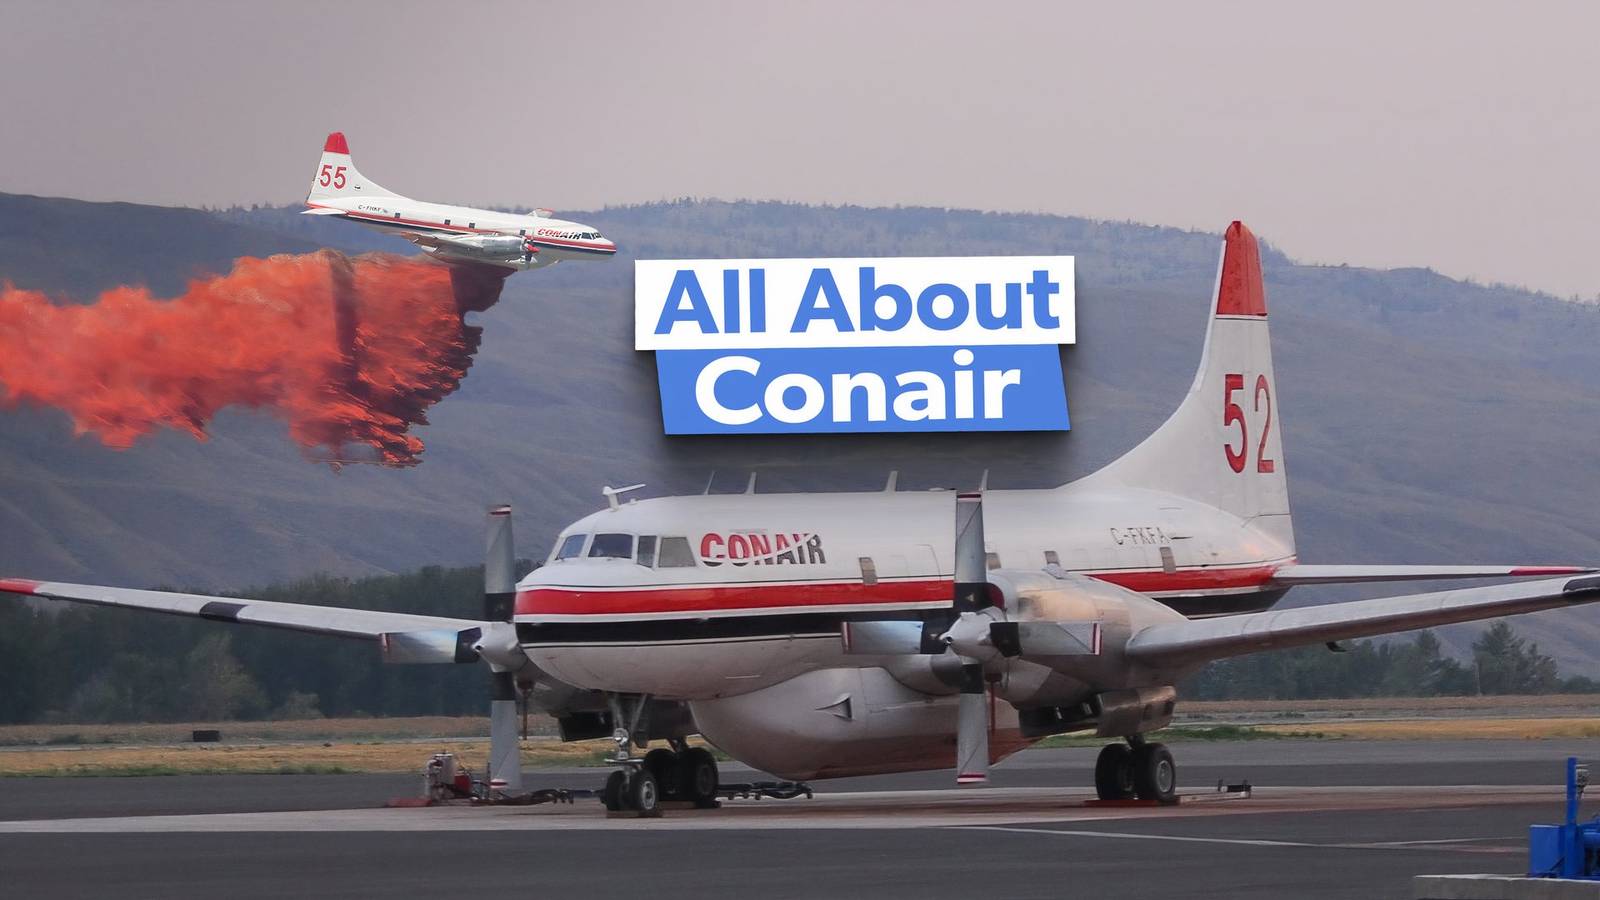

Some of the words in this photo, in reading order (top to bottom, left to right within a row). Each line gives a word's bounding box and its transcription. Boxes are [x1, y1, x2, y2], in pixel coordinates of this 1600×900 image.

[320, 164, 347, 190] 55
[537, 228, 581, 240] CONAIR
[1223, 373, 1275, 474] 52
[1110, 527, 1170, 545] C-FKFA
[700, 533, 827, 567] CONAIR
